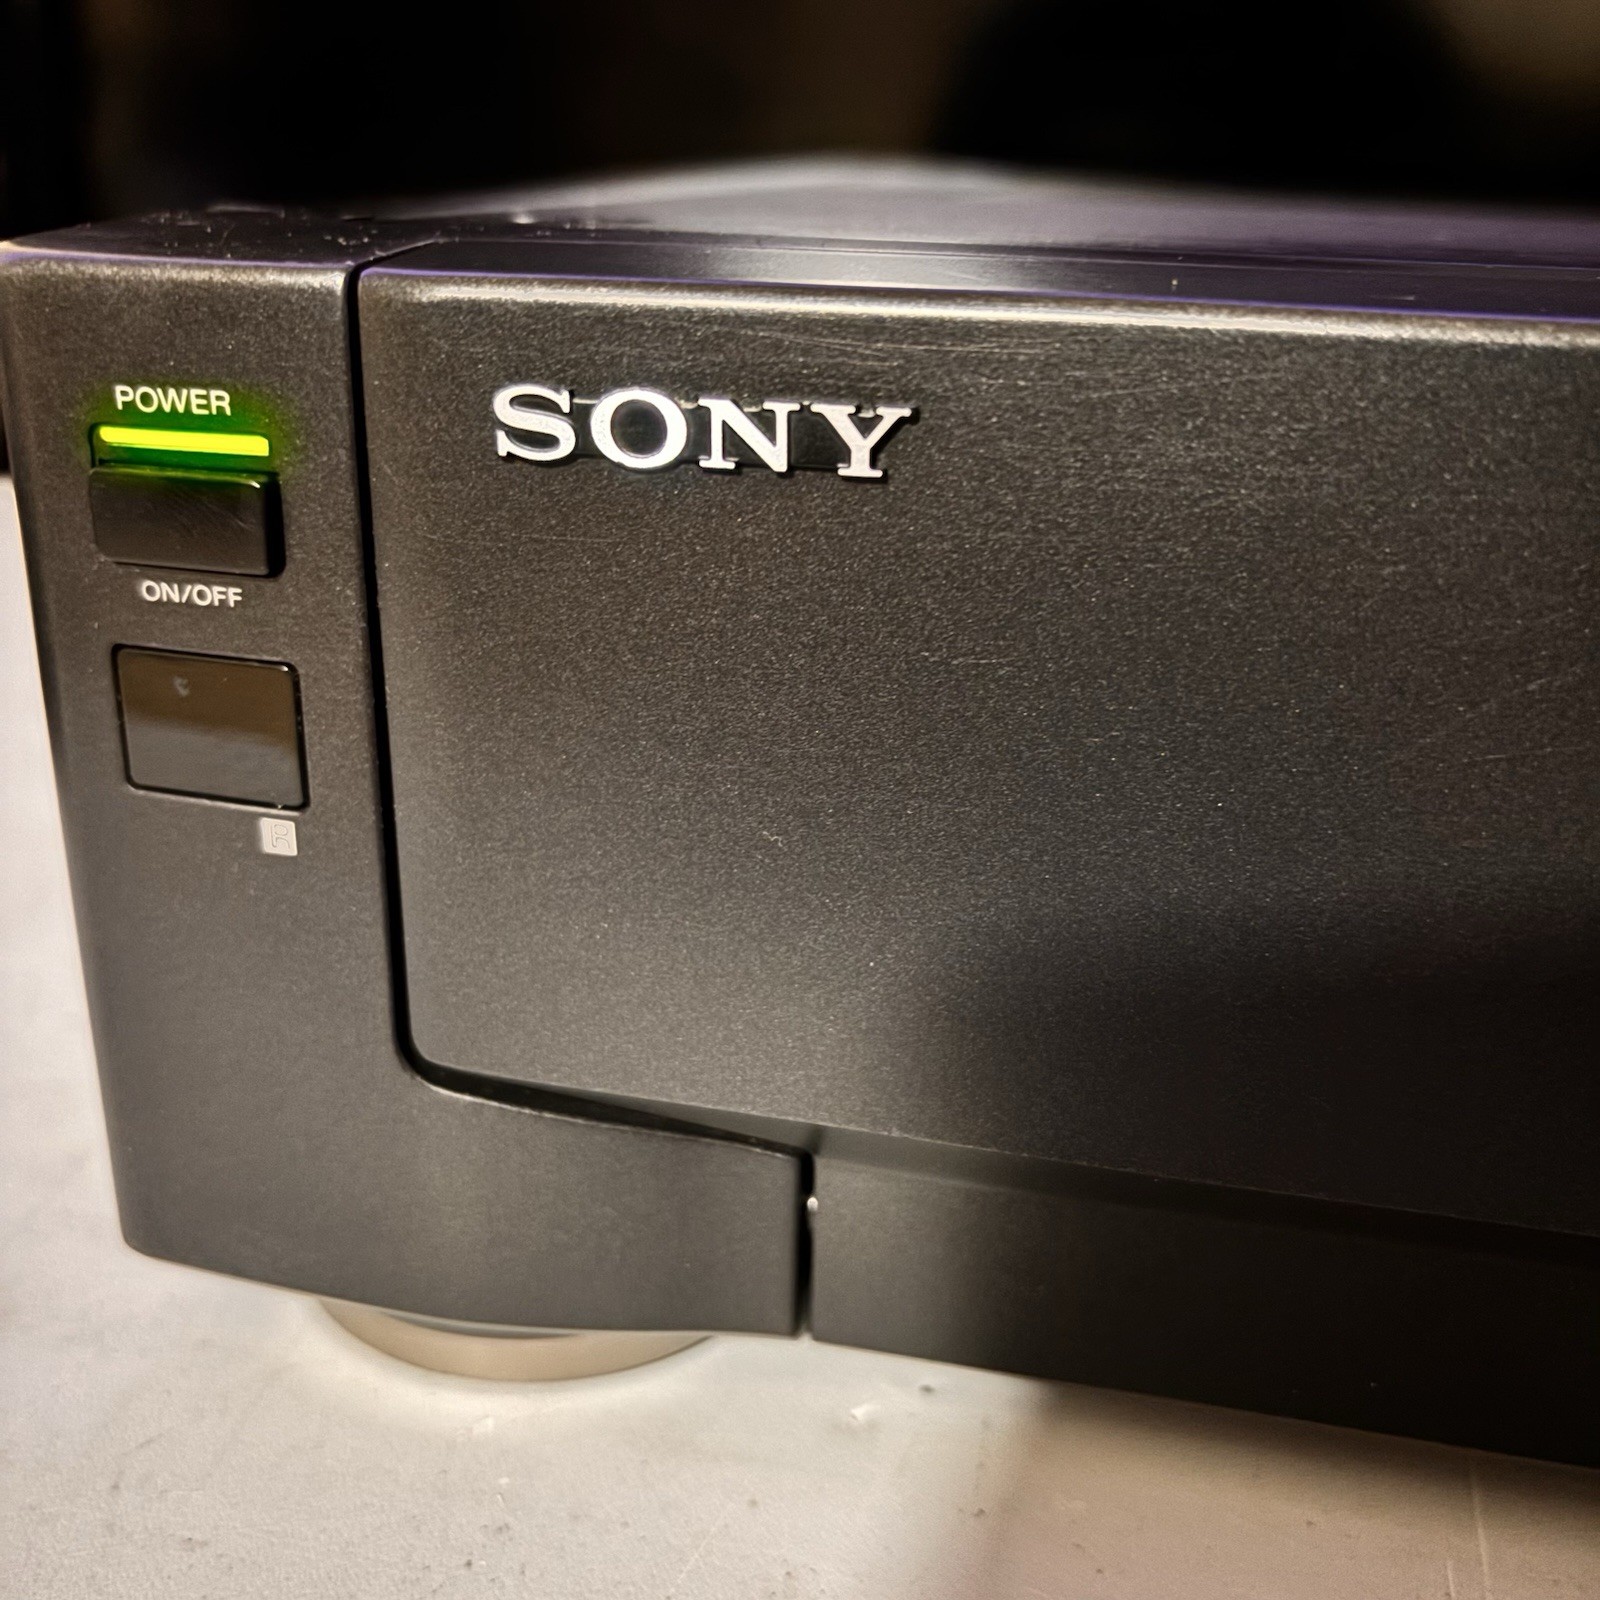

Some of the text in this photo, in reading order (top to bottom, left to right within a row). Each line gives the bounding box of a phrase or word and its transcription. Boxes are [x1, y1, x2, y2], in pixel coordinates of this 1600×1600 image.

[114, 384, 232, 416] POWER
[493, 384, 913, 478] SONY
[140, 580, 243, 608] ON/OFF
